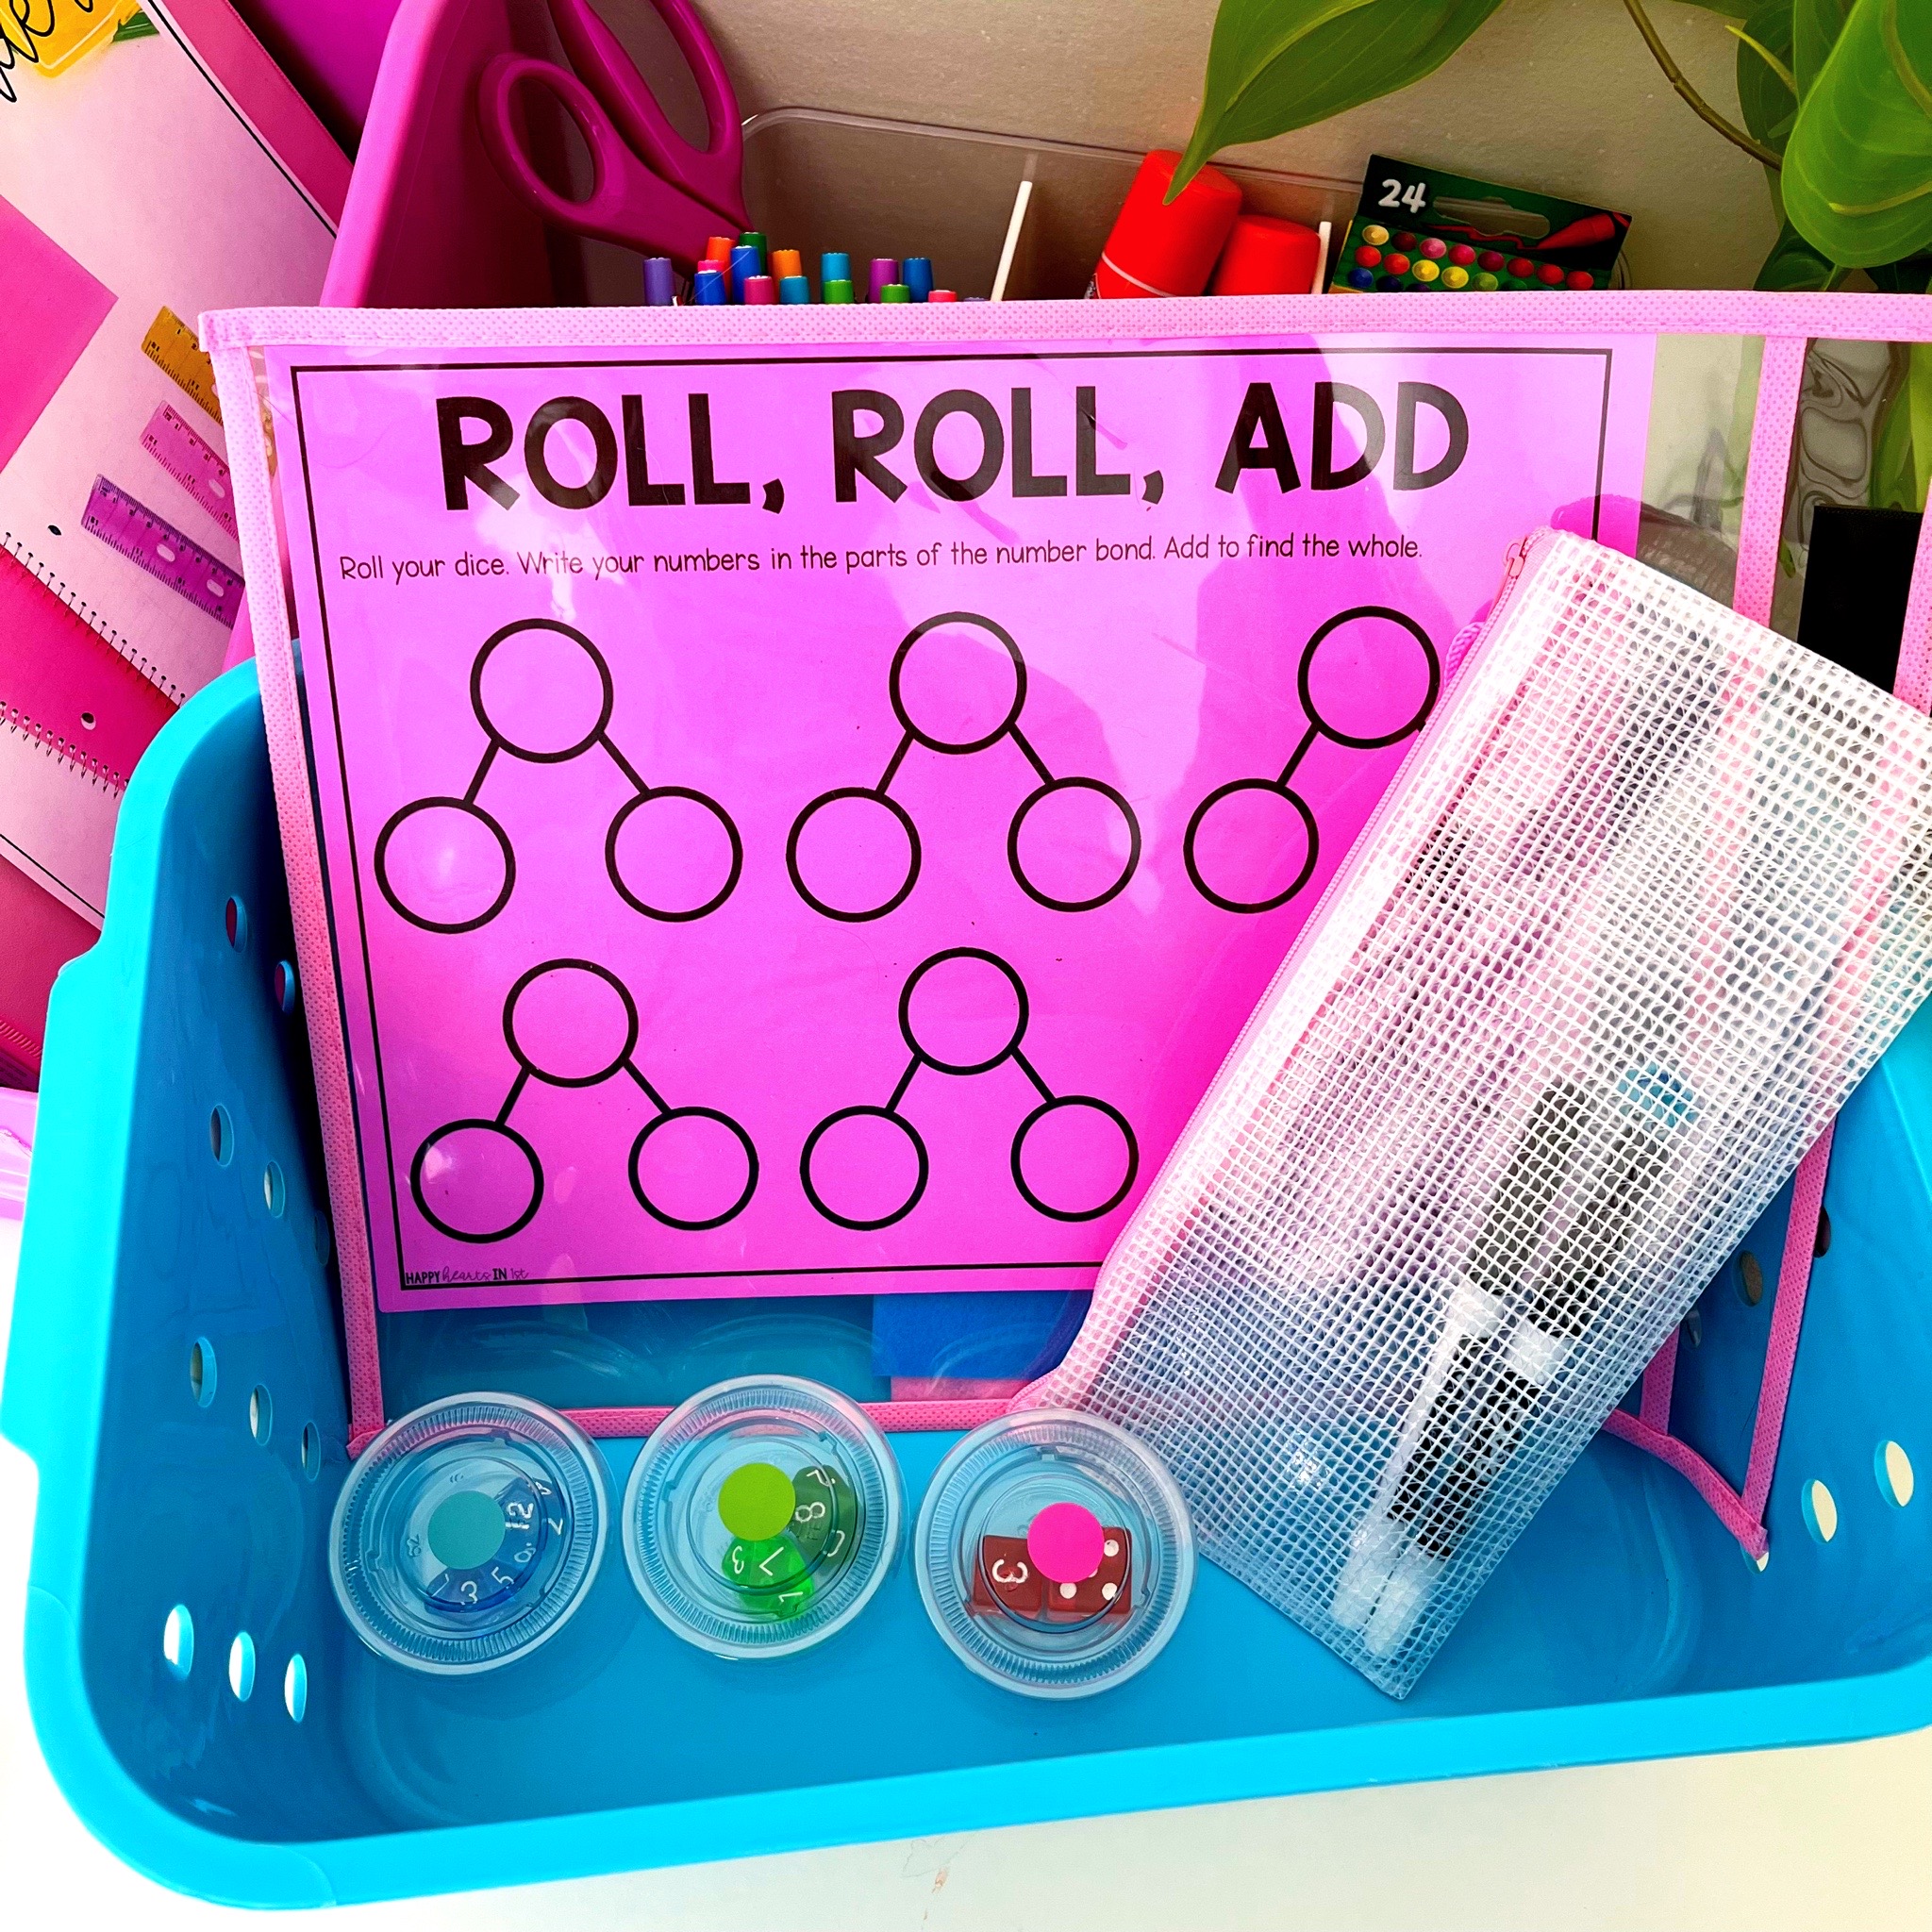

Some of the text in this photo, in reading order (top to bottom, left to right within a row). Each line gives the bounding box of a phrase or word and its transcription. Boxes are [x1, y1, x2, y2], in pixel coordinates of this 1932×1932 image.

[1378, 178, 1426, 213] 24
[435, 380, 1470, 515] ROLL, ROLL, ADD
[339, 531, 1424, 586] Roll your dice. Write your numbers in the parts of the number bond. Add to find the whole.
[406, 1271, 441, 1285] HAPPY
[441, 1266, 491, 1283] hearts
[492, 1267, 508, 1281] IN
[505, 1503, 534, 1531] 12
[732, 1545, 745, 1574] 3
[758, 1546, 785, 1576] 7
[991, 1558, 1030, 1584] 3
